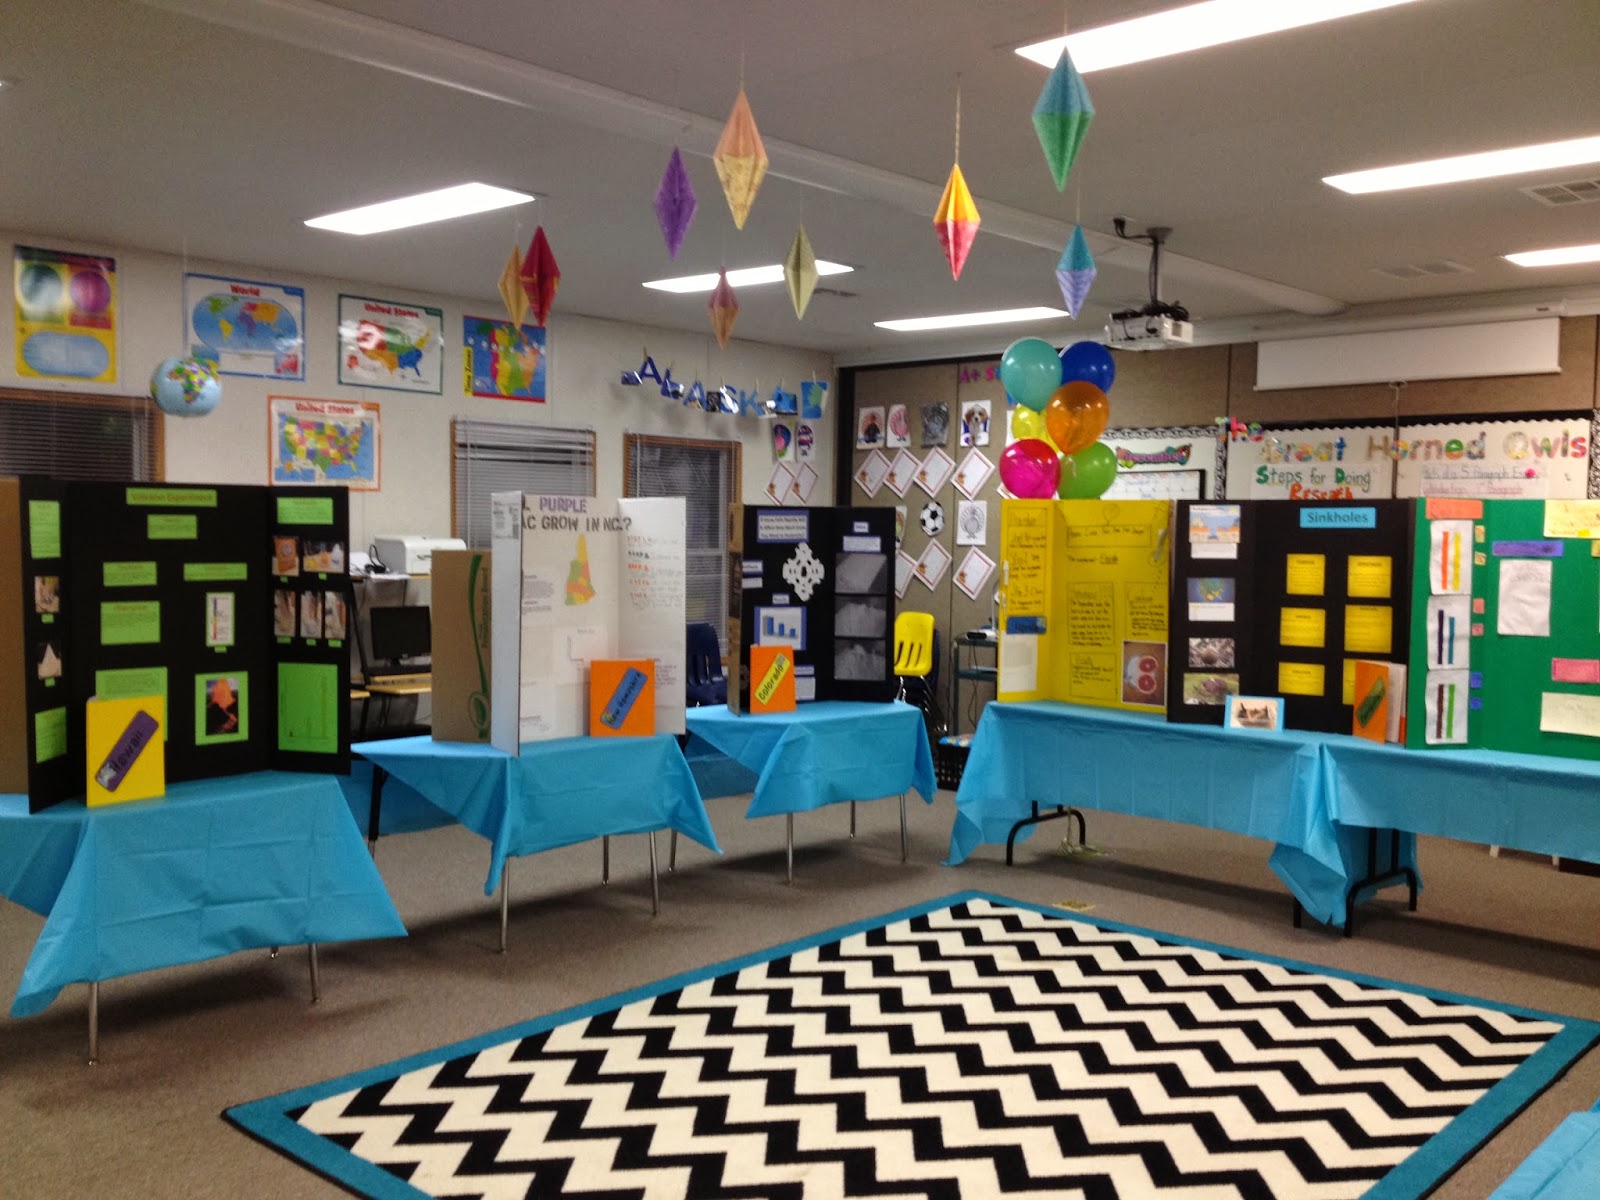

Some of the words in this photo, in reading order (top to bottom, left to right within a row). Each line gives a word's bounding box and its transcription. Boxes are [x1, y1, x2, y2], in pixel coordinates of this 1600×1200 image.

[1215, 416, 1264, 442] The
[1259, 437, 1346, 463] Great
[1367, 431, 1486, 462] Horned
[1503, 428, 1588, 460] Owls
[1256, 464, 1302, 489] Steps
[1310, 468, 1326, 484] for
[1335, 467, 1371, 492] Doing
[540, 496, 587, 513] PURPLE
[1307, 511, 1368, 524] Sinkholes
[542, 516, 578, 531] GROW
[586, 517, 600, 532] IN
[757, 663, 784, 701] Colorado
